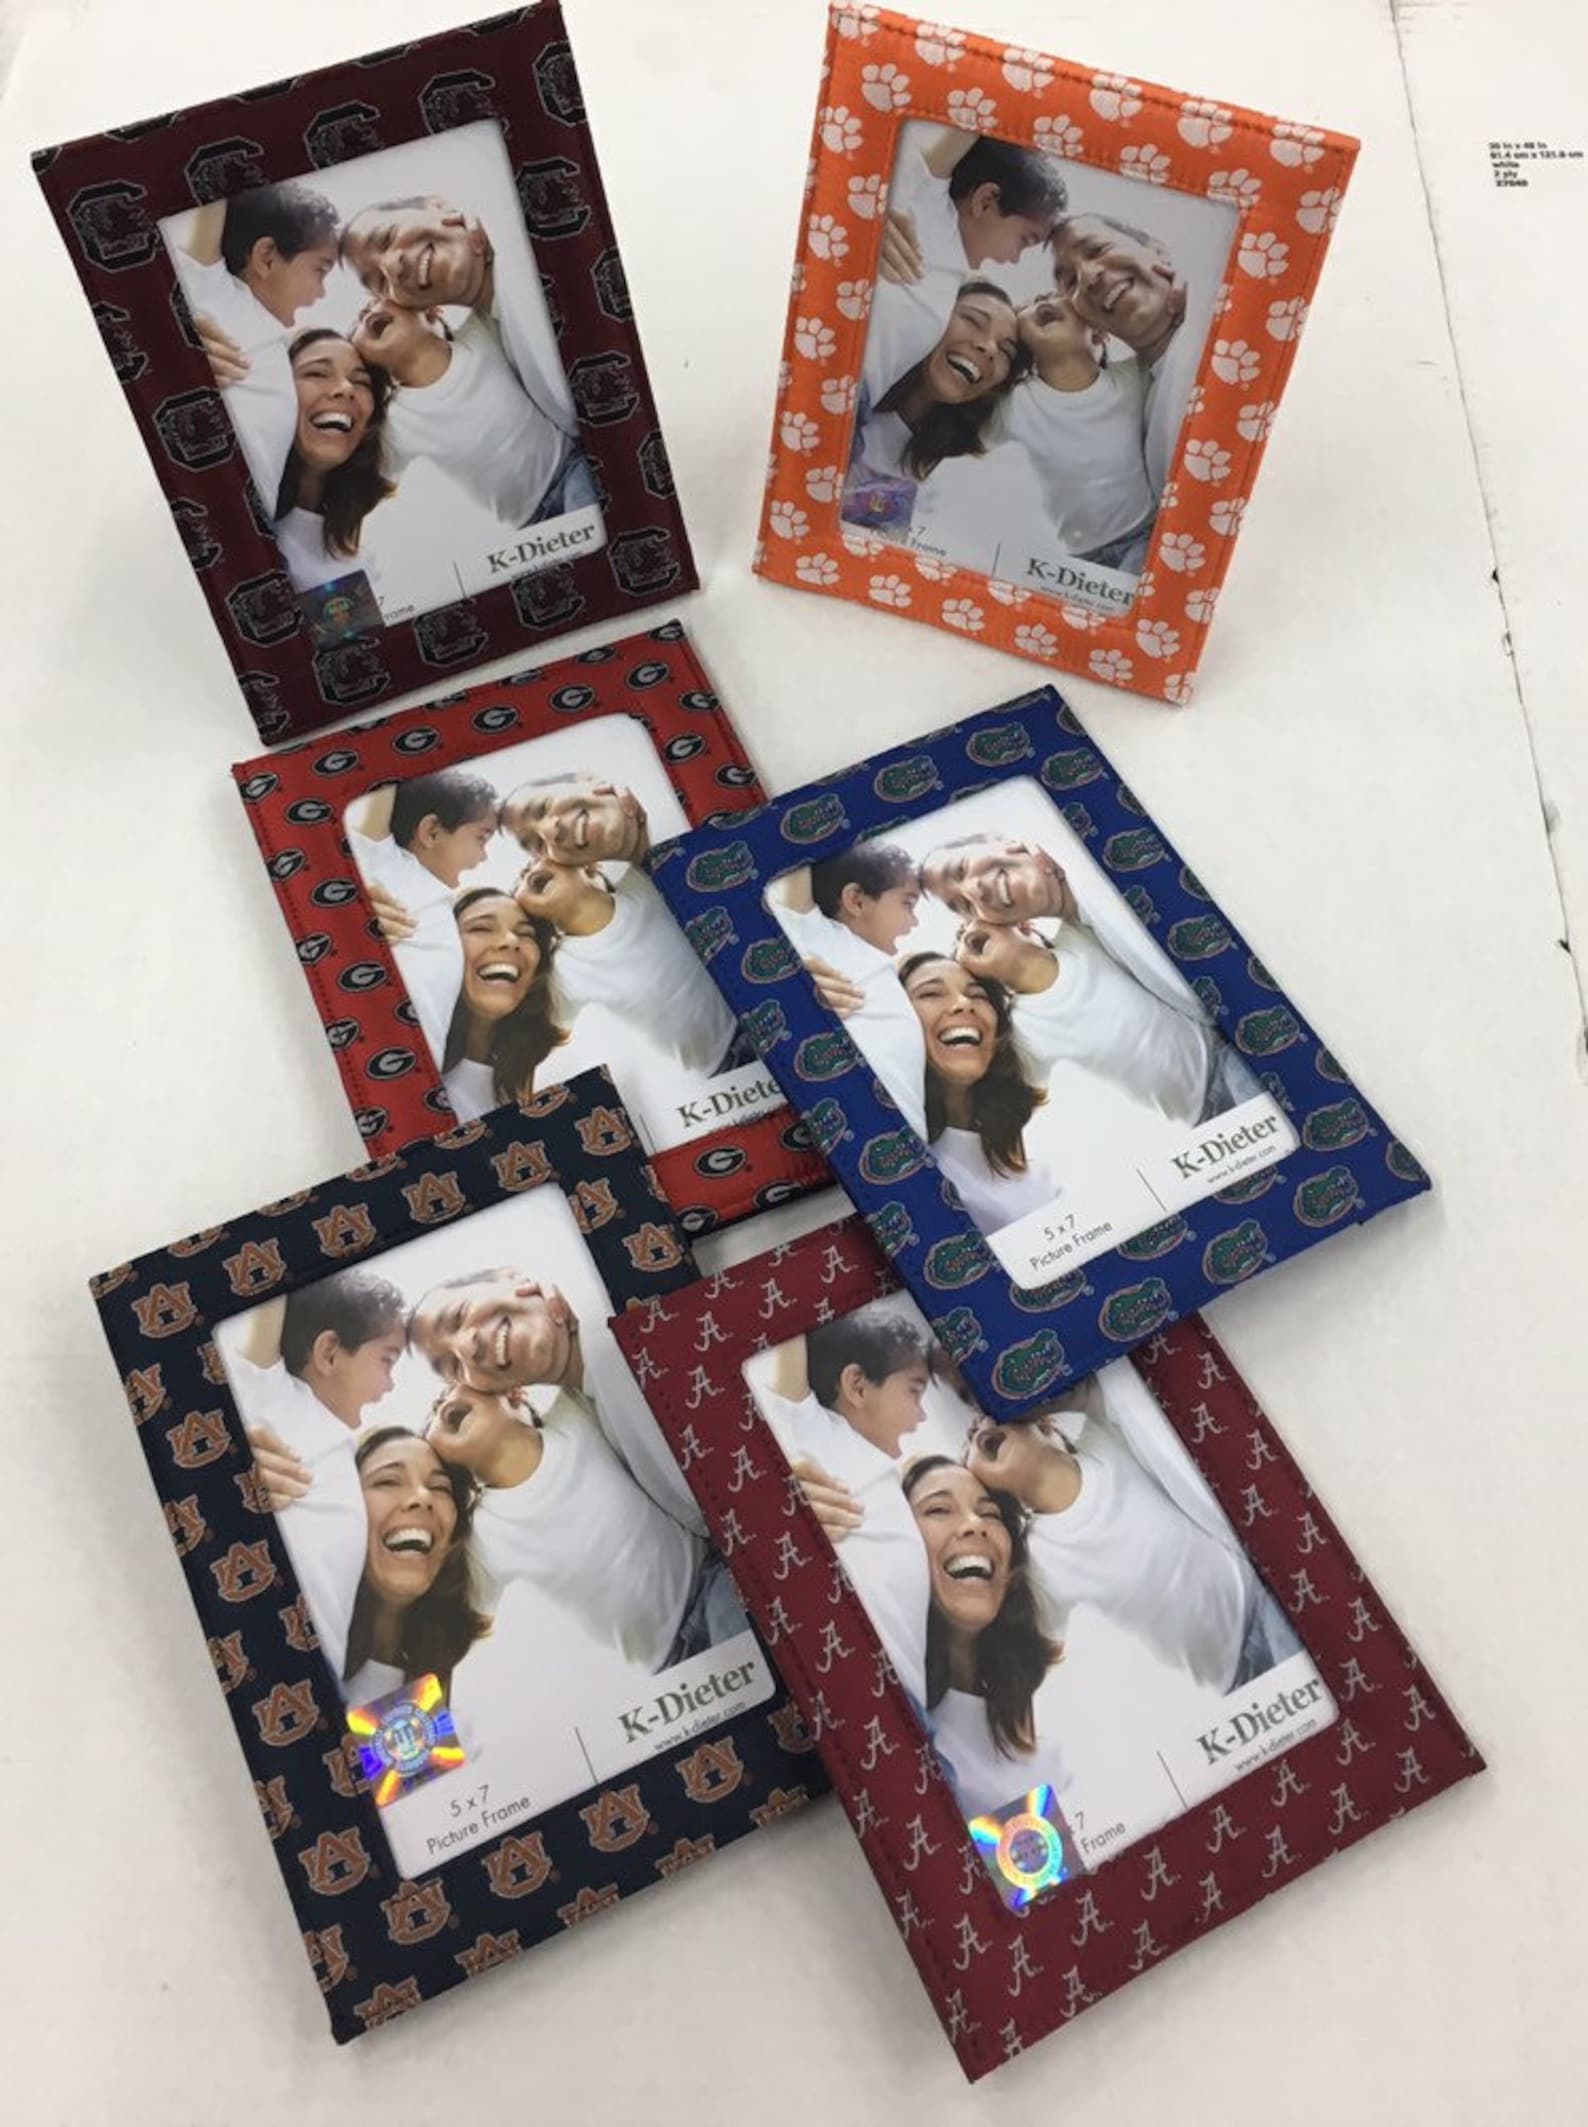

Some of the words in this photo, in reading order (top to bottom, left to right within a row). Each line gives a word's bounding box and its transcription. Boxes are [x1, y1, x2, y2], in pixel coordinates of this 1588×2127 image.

[487, 523, 595, 574] K-Dieter
[1026, 557, 1136, 607] K-Dieter
[383, 604, 415, 621] rame
[676, 1076, 783, 1128] K-Diete
[1170, 1113, 1278, 1180] K-Dieter
[1028, 1231, 1074, 1271] Picture
[1072, 1220, 1113, 1249] Frame
[1043, 1226, 1055, 1241] 5
[1066, 1213, 1077, 1229] 7
[616, 1659, 757, 1744] K-Dieter
[653, 1701, 747, 1752] www.k-dieter.com
[1196, 1677, 1322, 1767] K-Dieter
[1234, 1717, 1317, 1773] www.k-dieter.com
[426, 1821, 480, 1855] Picture
[480, 1794, 532, 1831] Frame
[450, 1800, 463, 1818] 5
[467, 1797, 479, 1810] x
[479, 1784, 491, 1803] 7
[1080, 1819, 1127, 1855] Frame
